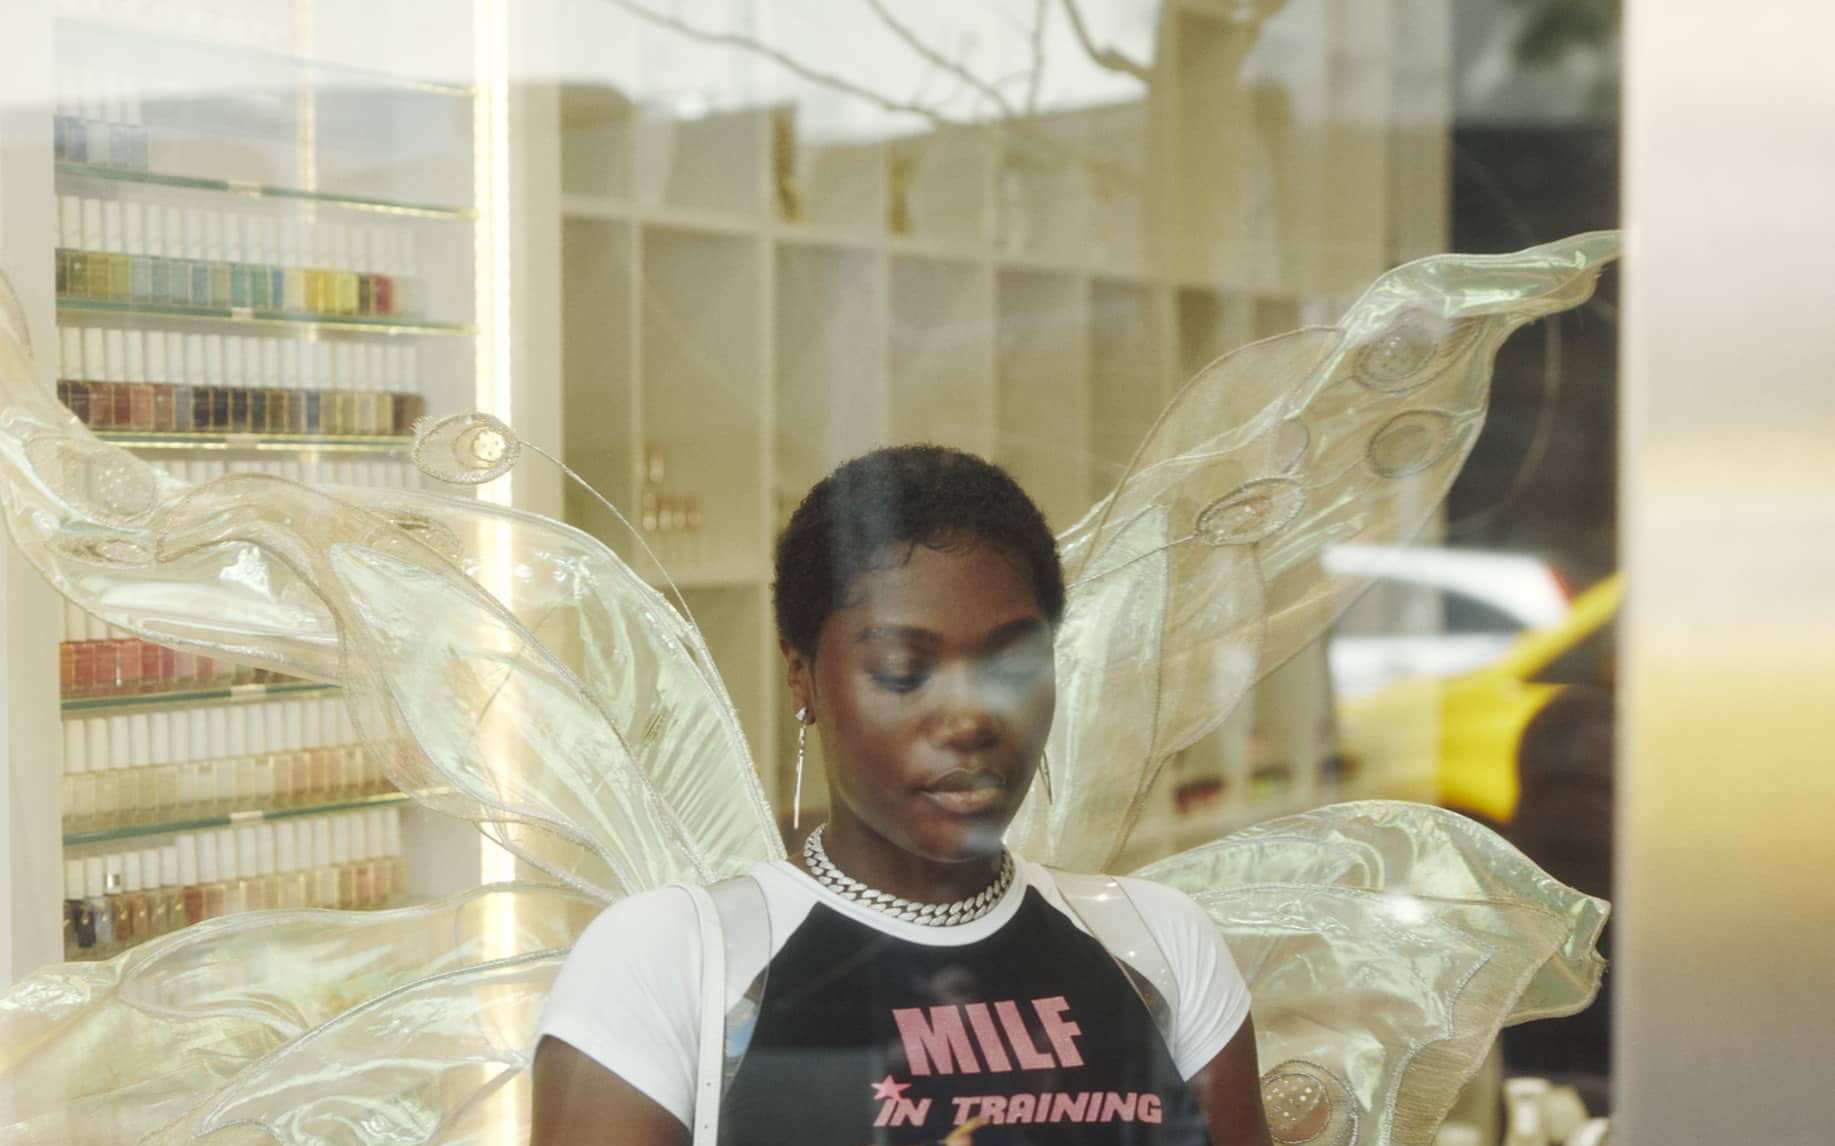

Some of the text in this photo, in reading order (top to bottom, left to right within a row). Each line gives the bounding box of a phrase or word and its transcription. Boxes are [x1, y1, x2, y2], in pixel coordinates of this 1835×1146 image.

[892, 996, 1084, 1076] MILF
[872, 1092, 1163, 1127] IN TRAINING
